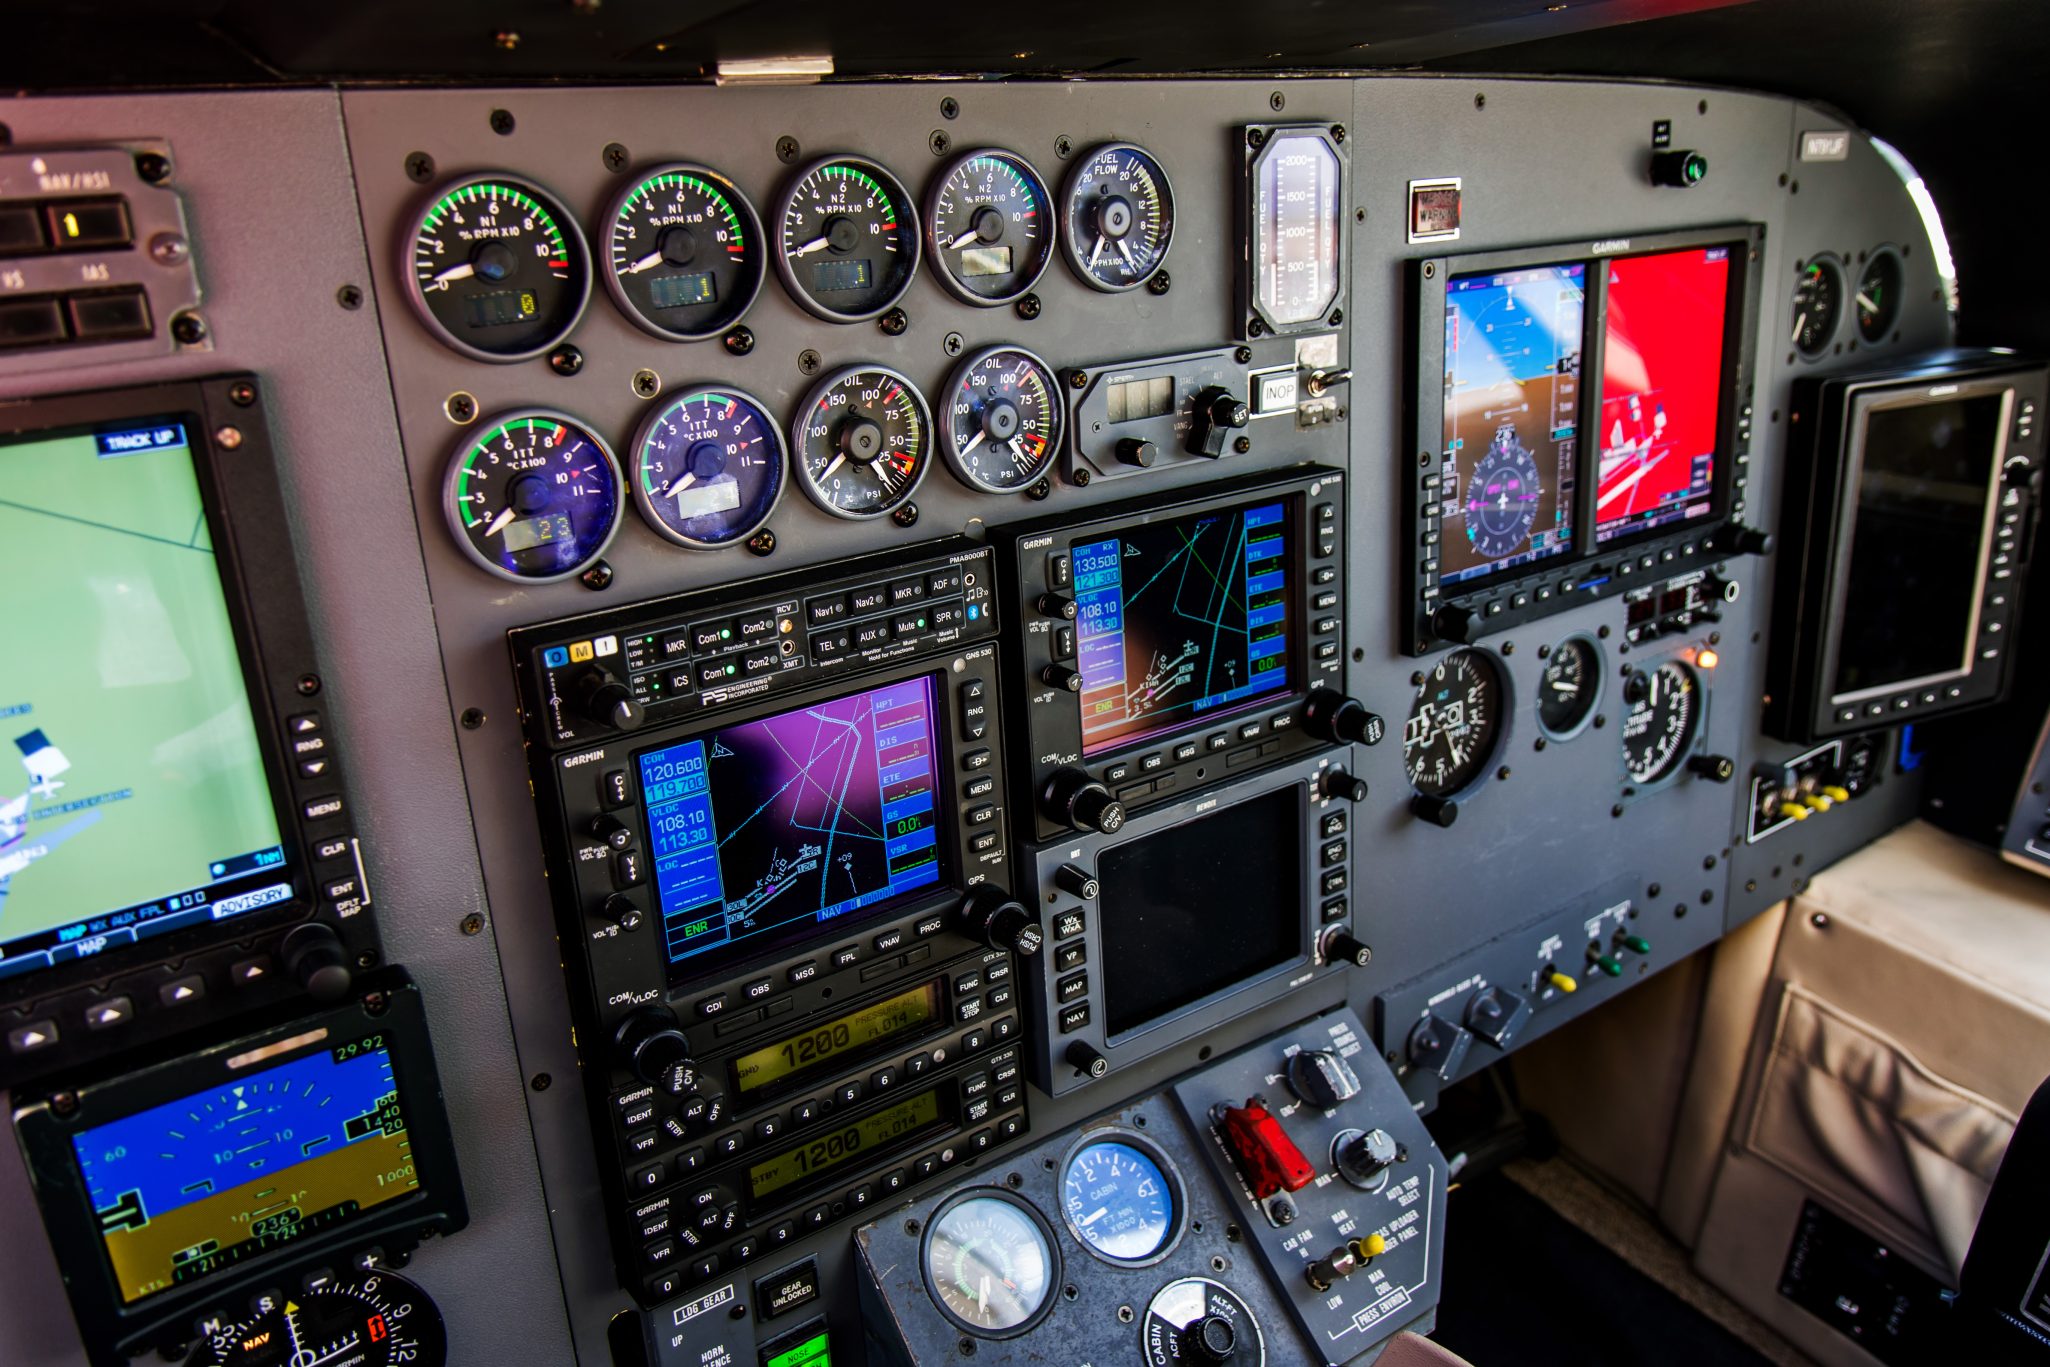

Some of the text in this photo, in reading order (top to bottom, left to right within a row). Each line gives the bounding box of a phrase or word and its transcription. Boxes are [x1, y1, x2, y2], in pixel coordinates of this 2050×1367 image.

[1286, 155, 1307, 166] 2000
[1094, 165, 1118, 175] FLOW
[1119, 171, 1130, 181] 20
[1286, 191, 1306, 201] 1500
[489, 202, 499, 214] 6
[717, 230, 728, 242] 10
[870, 223, 880, 235] 10
[1286, 227, 1306, 237] 1000
[536, 244, 549, 256] 10
[1592, 239, 1630, 254] GARMIN
[82, 264, 109, 281] IAS
[1287, 261, 1304, 272] 500
[985, 359, 1002, 370] OIL
[844, 375, 863, 387] OIL
[972, 375, 987, 386] 150
[1000, 373, 1016, 384] 100
[862, 389, 880, 401] 100
[1265, 384, 1295, 399] INOP
[830, 394, 847, 406] 150
[1020, 395, 1033, 405] 75
[885, 410, 899, 421] 75
[1234, 408, 1247, 423] SET
[811, 425, 828, 438] 100
[1023, 420, 1036, 429] 50
[107, 429, 175, 450] TRACK UP
[890, 436, 904, 446] 50
[513, 448, 534, 459] ITT
[727, 444, 738, 455] 10
[815, 457, 828, 468] 50
[556, 473, 568, 484] 10
[573, 485, 584, 496] 11
[866, 491, 881, 499] PSI
[1023, 536, 1053, 550] GARMIN
[949, 549, 989, 564] PMA8000BT
[1075, 554, 1118, 573] 133.500
[933, 579, 948, 591] ADF
[895, 588, 912, 599] MKR
[1319, 595, 1337, 605] MENU
[776, 604, 792, 614] RCV
[855, 596, 874, 608] Nav2
[815, 605, 833, 618] Nav1
[936, 611, 951, 623] SPR
[1081, 601, 1117, 620] 108.10
[742, 620, 765, 635] Com2
[898, 621, 915, 632] Mute
[1081, 617, 1118, 636] 113.30
[627, 638, 643, 647] HIGH
[698, 631, 721, 646] Com1
[860, 630, 876, 642] AUX
[666, 639, 686, 654] MKR
[819, 640, 835, 652] TEL
[747, 655, 770, 671] Com2
[782, 658, 799, 670] XMT
[673, 674, 689, 688] ICS
[703, 667, 727, 681] Com1
[728, 684, 769, 699] INCORPORATED
[967, 705, 984, 717] RNG
[1095, 700, 1113, 713] ENR
[1273, 716, 1291, 728] PROC
[1243, 726, 1260, 738] VNAV
[296, 738, 323, 753] RNG
[1214, 737, 1226, 747] FPL
[564, 750, 605, 768] GARMIN
[1179, 747, 1195, 758] MSG
[645, 757, 703, 783] 120.600
[1146, 758, 1161, 768] OBS
[883, 773, 900, 784] ETE
[1113, 769, 1125, 779] CDI
[647, 773, 706, 801] 119.700
[970, 782, 992, 795] MENU
[307, 800, 342, 817] MENU
[657, 810, 705, 834] 108.10
[976, 810, 991, 822] CLR
[659, 828, 708, 852] 113.30
[978, 838, 994, 848] ENT
[321, 841, 346, 856] CLR
[658, 860, 679, 873] LOC
[968, 873, 985, 886] GPS
[330, 881, 354, 896] ENT
[219, 887, 285, 915] ADVISORY
[336, 897, 360, 912] DFLT
[340, 905, 361, 920] MAP
[822, 905, 842, 920] NAV
[58, 924, 87, 942] MAP
[111, 910, 138, 928] AUX
[140, 902, 165, 920] FPL
[685, 921, 708, 937] ENR
[920, 920, 941, 935] PROC
[76, 938, 107, 958] MAP
[879, 935, 900, 949] VNAV
[840, 952, 856, 964] FPL
[1066, 950, 1077, 961] VP
[795, 968, 815, 981] MSG
[990, 967, 1009, 980] CRSR
[751, 983, 770, 996] OBS
[959, 979, 979, 992] FUNC
[1065, 981, 1083, 993] MAP
[609, 989, 659, 1006] COM/VLOC
[994, 992, 1009, 1003] CLR
[706, 1001, 722, 1013] CDI
[1066, 1011, 1085, 1024] NAV
[336, 1036, 384, 1060] 29.92
[779, 1023, 850, 1068] 1200
[674, 1065, 684, 1091] PUSH
[997, 1067, 1016, 1081] CRSR
[968, 1080, 987, 1094] FUNC
[619, 1086, 654, 1105] GARMIN
[1002, 1092, 1017, 1103] CLR
[382, 1105, 401, 1119] 40
[687, 1104, 703, 1117] ALT
[710, 1103, 721, 1121] OFF
[969, 1101, 988, 1114] START
[627, 1108, 653, 1124] IDENT
[636, 1138, 655, 1150] VFR
[793, 1127, 861, 1174] 1200
[104, 1147, 127, 1162] 60
[214, 1150, 234, 1165] 10
[376, 1165, 415, 1187] 1000
[1084, 1169, 1097, 1182] 2
[1314, 1173, 1332, 1188] MAN
[1090, 1182, 1119, 1201] CABIN
[1386, 1175, 1420, 1201] AUTO TEMP
[1398, 1188, 1421, 1207] SELECT
[636, 1197, 670, 1217] GARMIN
[702, 1213, 718, 1227] ALT
[1331, 1209, 1349, 1224] MAN
[281, 1225, 299, 1240] 24
[643, 1220, 669, 1236] IDENT
[1337, 1219, 1356, 1236] HEAT
[1398, 1226, 1419, 1243] PANEL
[653, 1247, 671, 1261] VFR
[1368, 1268, 1386, 1284] MAN
[364, 1276, 381, 1293] 6
[781, 1281, 802, 1295] GEAR
[1374, 1280, 1393, 1296] COOL
[772, 1284, 812, 1308] UNLOCKED
[1326, 1294, 1344, 1310] LOW
[681, 1290, 727, 1319] LDG GEAR
[1211, 1294, 1238, 1316] ALT-FT
[243, 1332, 270, 1351] NAV
[671, 1334, 683, 1347] UP
[1151, 1323, 1167, 1366] CABIN
[1169, 1331, 1181, 1358] ACFT
[398, 1339, 419, 1361] 12
[701, 1344, 724, 1363] HORN
[787, 1347, 809, 1364] NOSE
